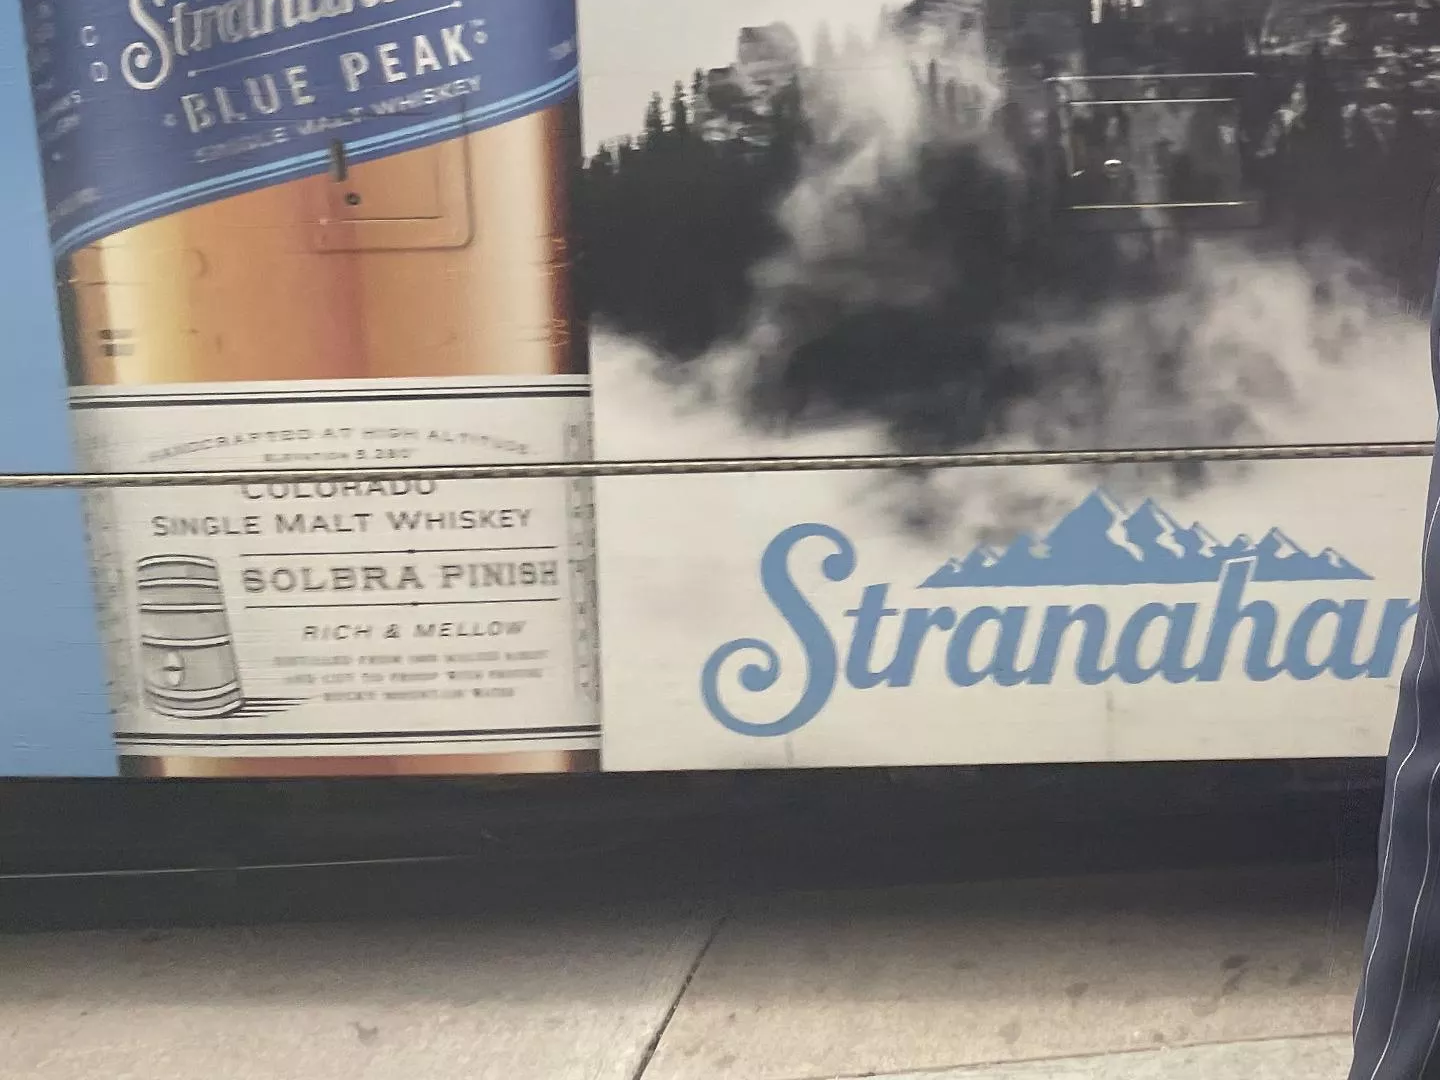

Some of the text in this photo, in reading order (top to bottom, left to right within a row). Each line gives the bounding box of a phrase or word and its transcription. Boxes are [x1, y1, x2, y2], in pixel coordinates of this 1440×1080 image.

[180, 63, 315, 134] BLUE
[339, 21, 474, 92] PEAK
[319, 427, 353, 440] AT
[241, 479, 437, 500] COLORADO
[151, 508, 533, 538] SINGLE MALT WHISKEY
[302, 619, 528, 642] RICH & MELLOW
